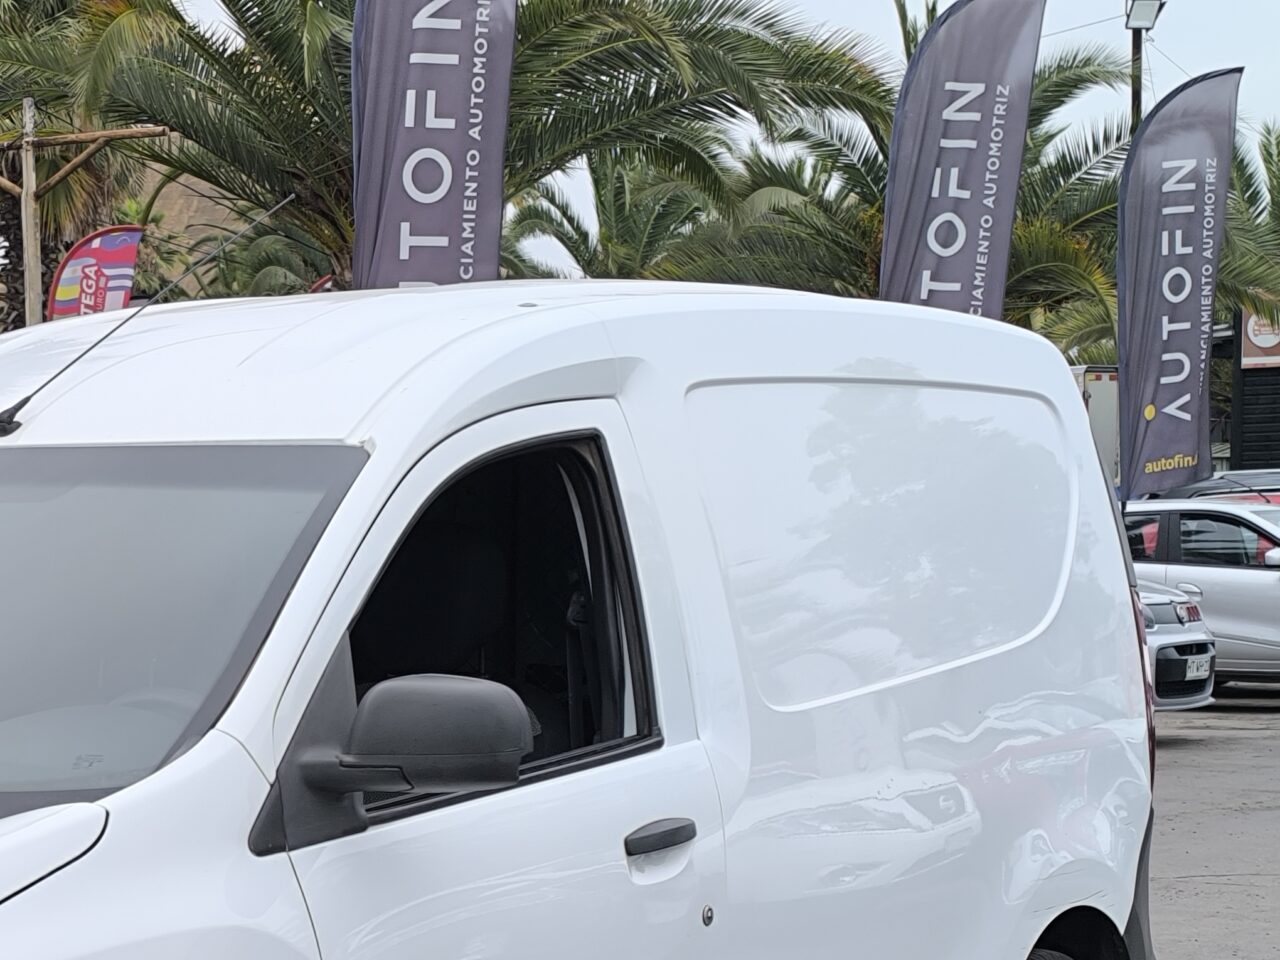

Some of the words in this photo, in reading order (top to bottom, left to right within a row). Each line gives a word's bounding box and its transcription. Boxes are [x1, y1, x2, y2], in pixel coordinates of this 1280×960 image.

[398, 0, 462, 288] TOFIN
[983, 84, 1010, 209] AUTOMOTRIZ
[1202, 157, 1218, 259] AUTOMOTRIZ
[1160, 158, 1198, 421] AUTOFIN
[1144, 452, 1198, 474] autofin.
